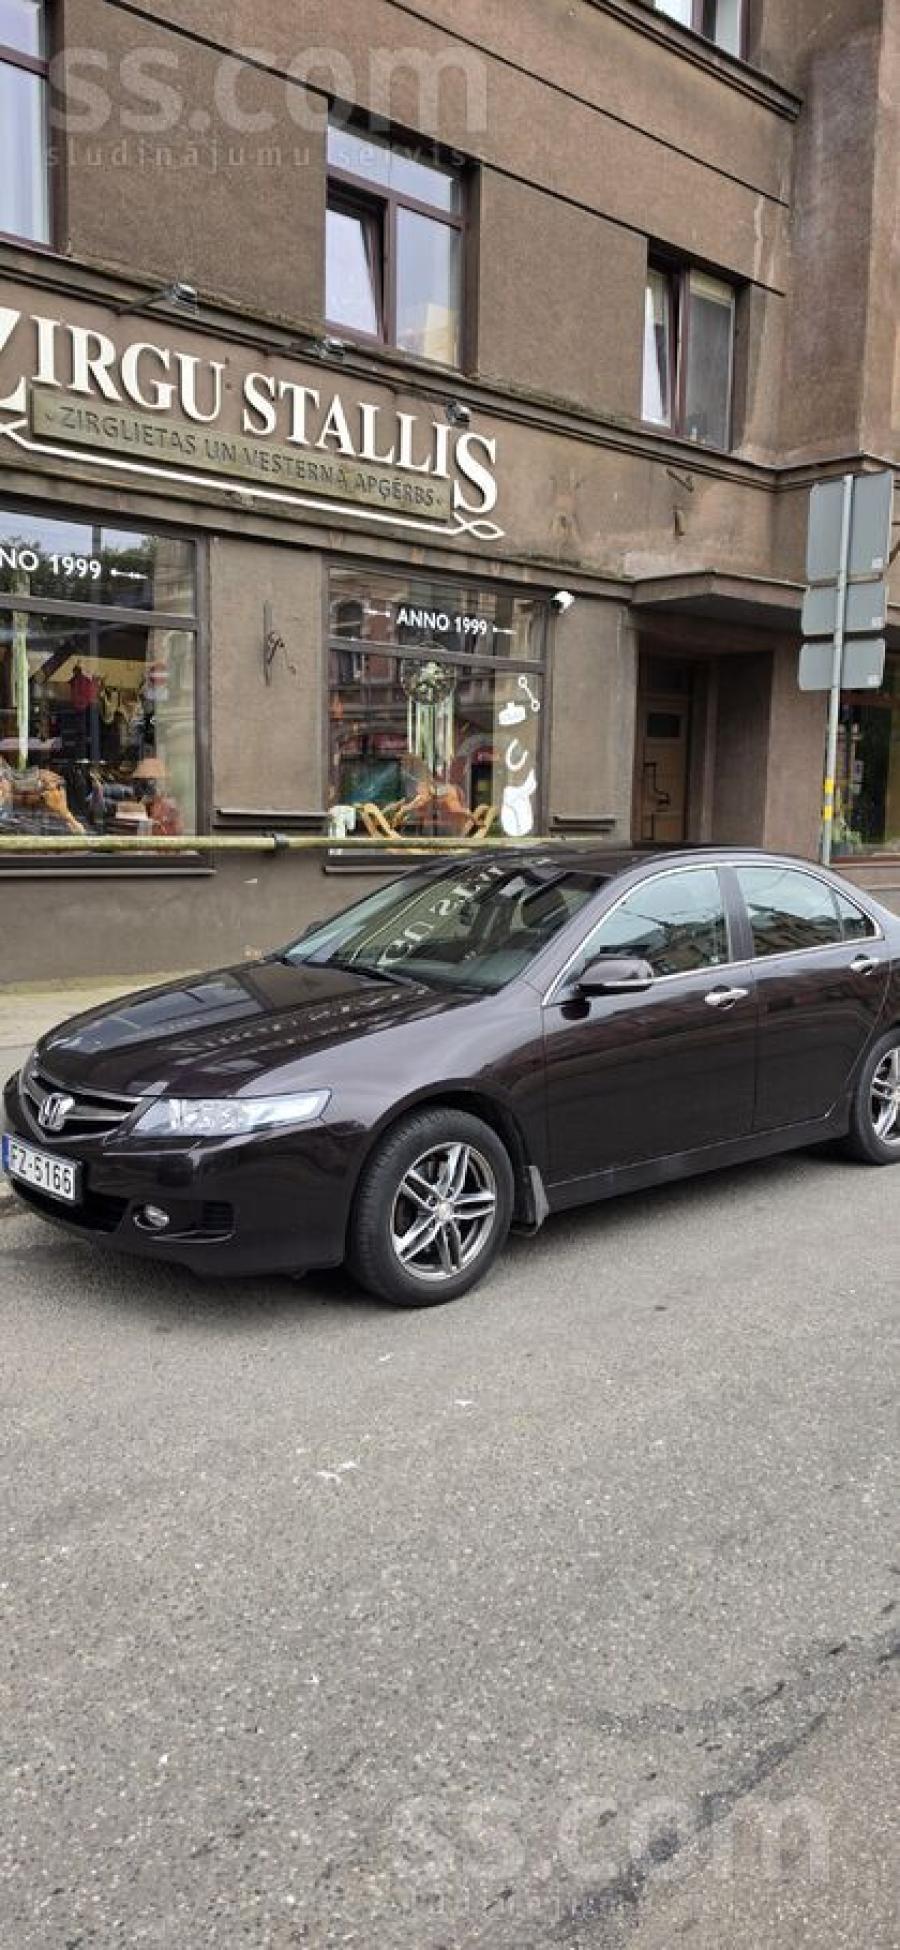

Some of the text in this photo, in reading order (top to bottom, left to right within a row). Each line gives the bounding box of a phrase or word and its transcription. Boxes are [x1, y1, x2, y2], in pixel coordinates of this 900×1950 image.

[59, 406, 197, 455] ZIRGLIETAS
[204, 438, 237, 463] UN
[242, 372, 497, 512] STALLIS
[49, 554, 102, 580] 1999
[396, 607, 488, 635] ANNO 1999
